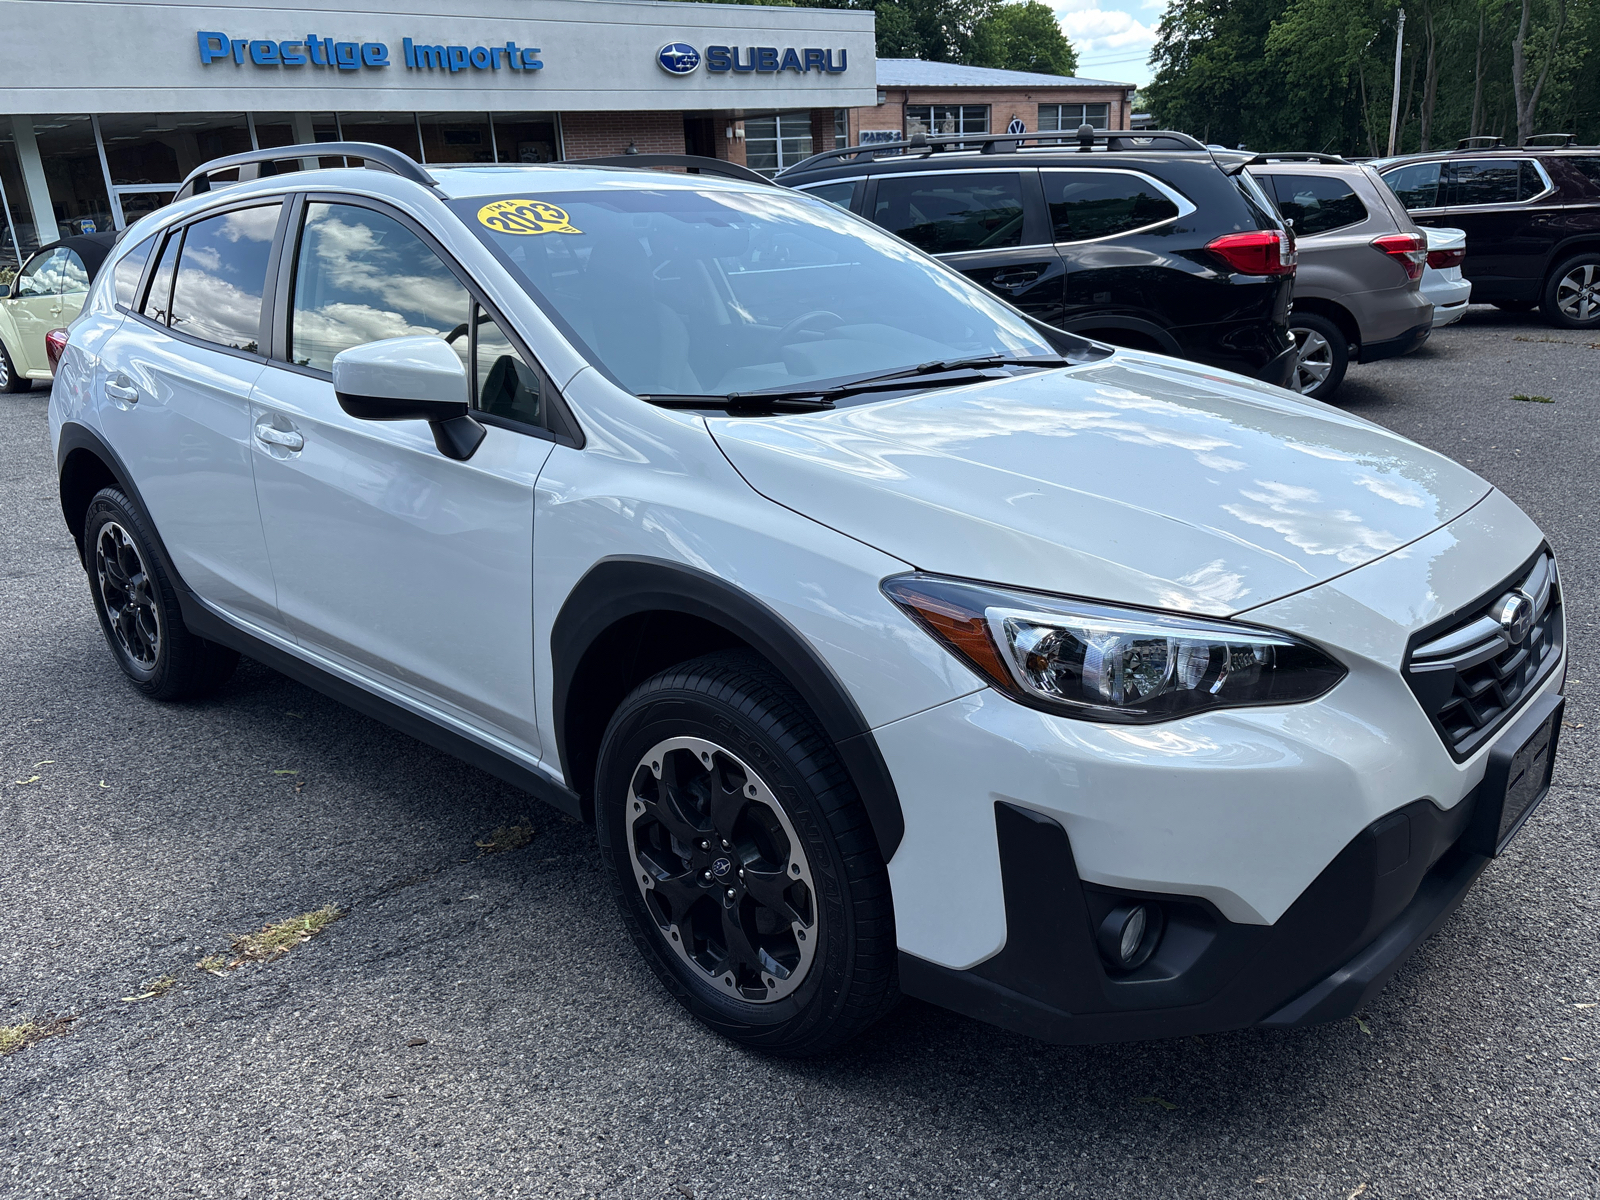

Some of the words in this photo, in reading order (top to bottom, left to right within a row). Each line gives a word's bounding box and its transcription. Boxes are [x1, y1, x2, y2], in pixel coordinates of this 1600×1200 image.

[197, 31, 390, 70] Prestige
[403, 37, 544, 72] Imports
[706, 45, 848, 72] SUBARU
[863, 131, 893, 142] PARTS
[486, 203, 507, 212] I'M
[486, 203, 566, 232] 2023
[712, 712, 843, 929] GEOLANDAR
